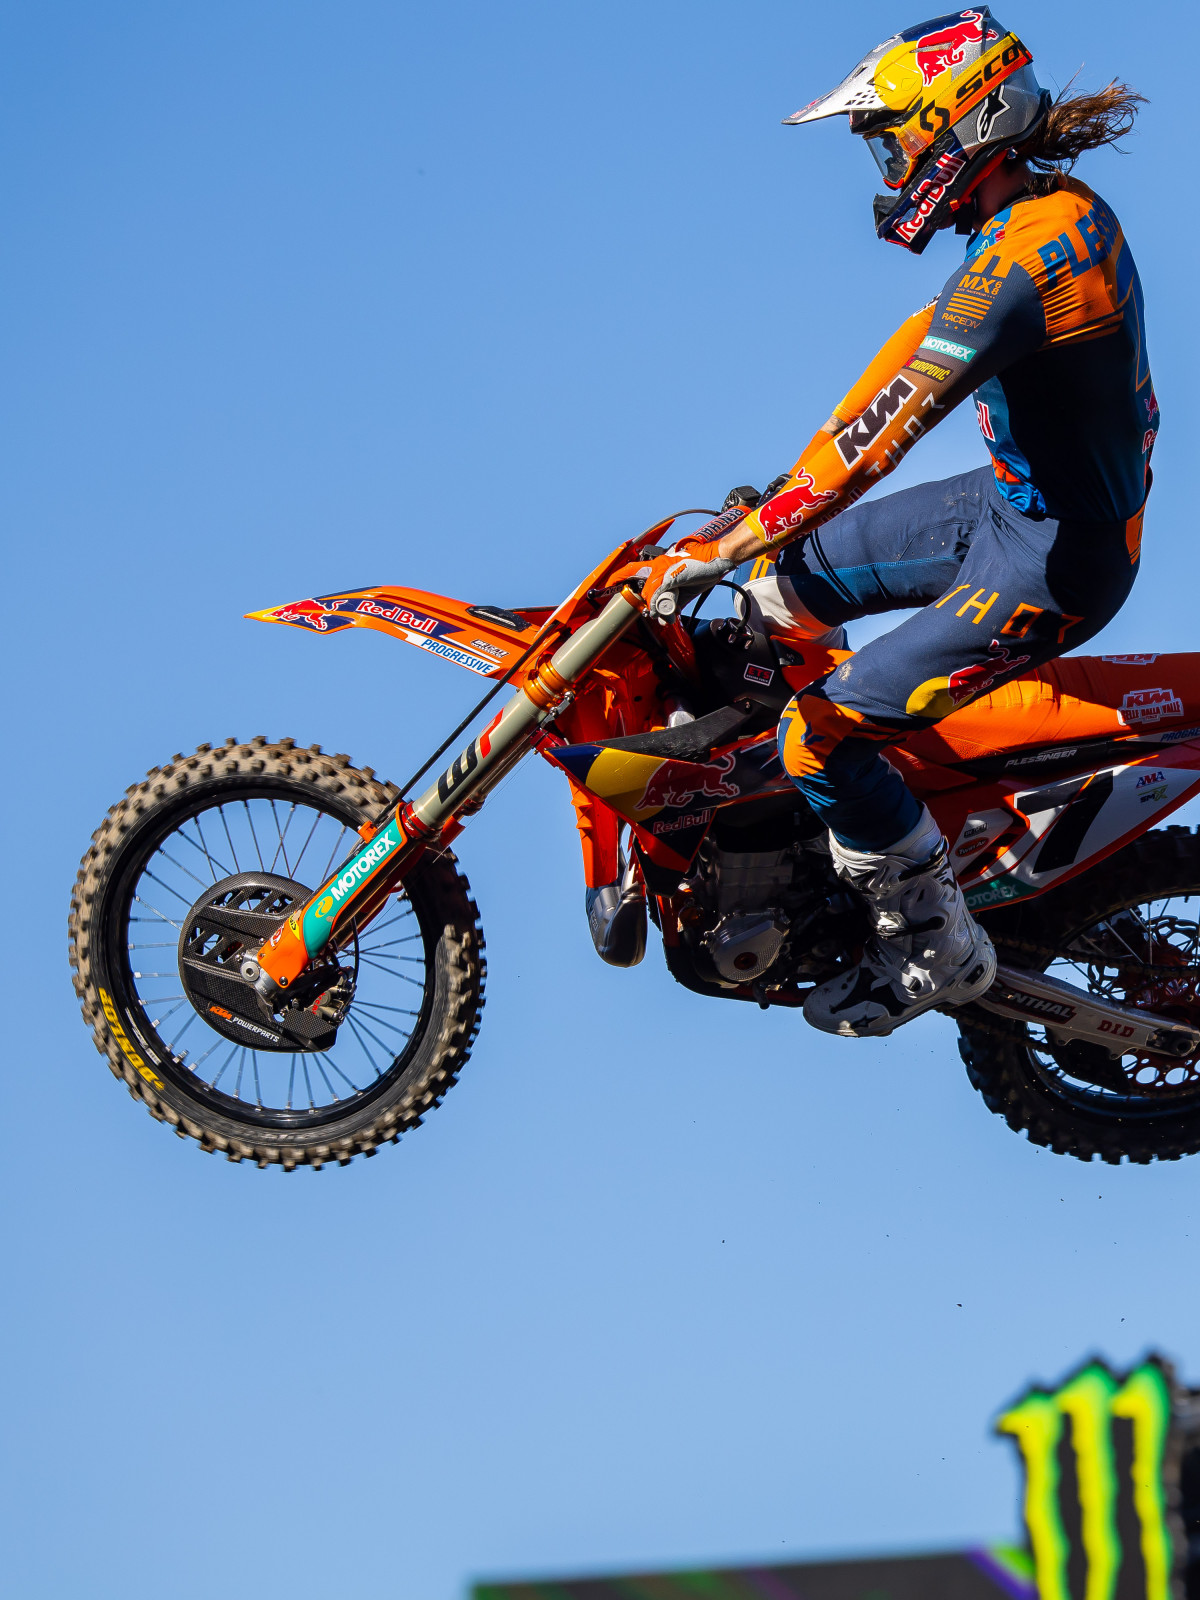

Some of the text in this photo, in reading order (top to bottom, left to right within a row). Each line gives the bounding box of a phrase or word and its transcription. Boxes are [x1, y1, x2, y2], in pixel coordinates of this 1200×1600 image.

[918, 152, 967, 203] Bull
[958, 274, 993, 292] MX
[923, 337, 973, 360] MOTOREX
[834, 374, 918, 470] KTM
[695, 507, 745, 542] RENTHAL
[356, 600, 438, 634] Red Bull
[421, 638, 495, 674] PROGRESSIVE
[748, 666, 771, 680] ETS
[1126, 689, 1172, 708] KTM
[1005, 749, 1077, 768] PLESSINGER
[1135, 771, 1166, 788] AMA
[653, 809, 711, 835] Red Bull
[1016, 770, 1113, 874] 7
[331, 831, 397, 902] MOTOREX
[965, 884, 1019, 908] OTOREX
[1010, 990, 1075, 1018] NTHAL
[209, 1005, 280, 1043] KTM POWERPARTS
